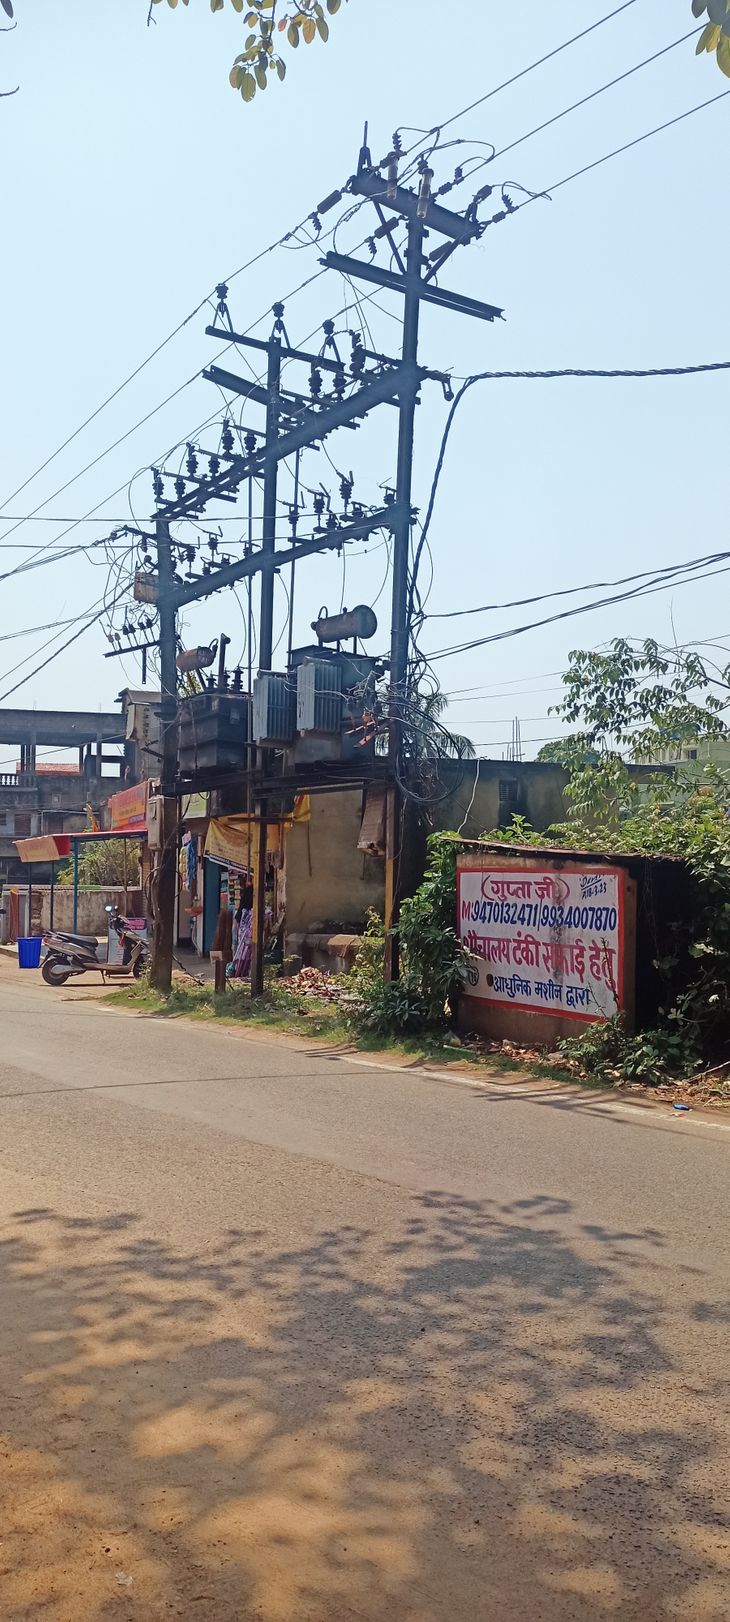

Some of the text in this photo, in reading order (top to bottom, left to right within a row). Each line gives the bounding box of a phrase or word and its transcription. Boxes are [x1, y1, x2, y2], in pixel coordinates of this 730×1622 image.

[512, 931, 541, 968] टंकी
[493, 974, 532, 999] आधुनिक
[534, 978, 563, 1002] मशीन
[566, 984, 591, 1009] द्वारा
